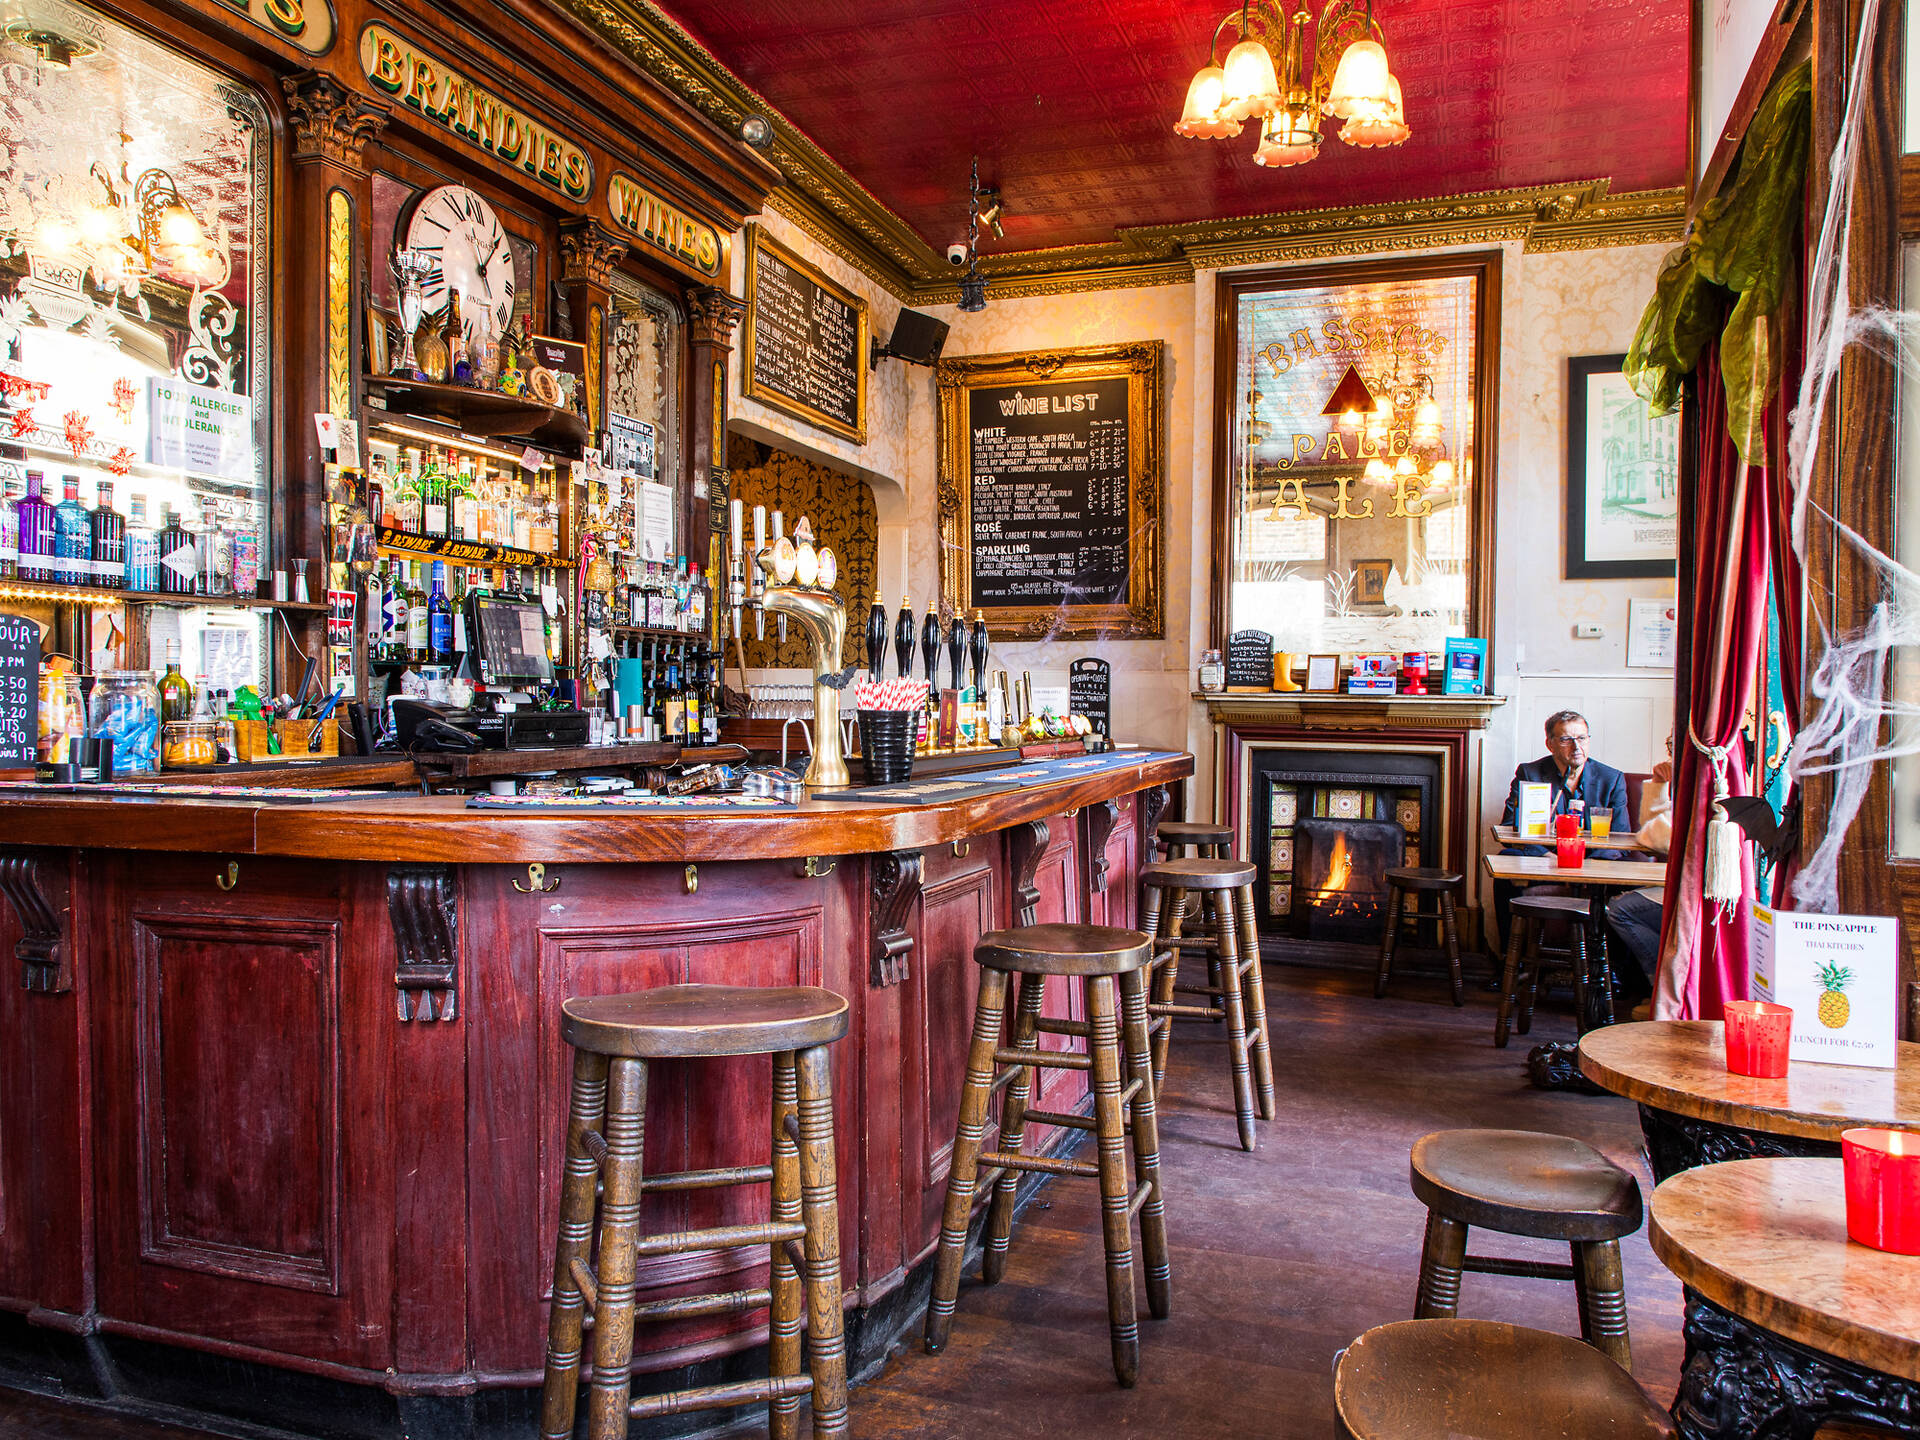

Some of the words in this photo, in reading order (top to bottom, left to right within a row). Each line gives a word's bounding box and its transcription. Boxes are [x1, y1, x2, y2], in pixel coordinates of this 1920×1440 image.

[368, 29, 587, 198] BRANDIES
[613, 178, 715, 271] WINES
[1257, 316, 1370, 380] BASS
[190, 395, 243, 416] ALLERGIES
[1052, 393, 1099, 413] LIST
[194, 410, 210, 420] and
[611, 414, 645, 434] HALLOWEEN
[974, 427, 1006, 439] WHITE
[1277, 429, 1413, 471] PALE
[974, 475, 996, 486] RED
[1263, 474, 1433, 522] ALE
[974, 521, 1002, 533] ROSÉ
[391, 534, 435, 551] BEWARE
[975, 544, 1030, 555] SPARKLING
[452, 543, 489, 560] BEWARE
[504, 550, 537, 566] BEWARE
[23, 747, 37, 760] 17
[1792, 921, 1815, 931] THE
[1818, 922, 1878, 934] PINEAPPLE
[1805, 940, 1825, 949] THAI
[1826, 941, 1865, 951] KITCHEN
[1793, 1035, 1827, 1046] LUNCH
[1830, 1037, 1849, 1047] FOR
